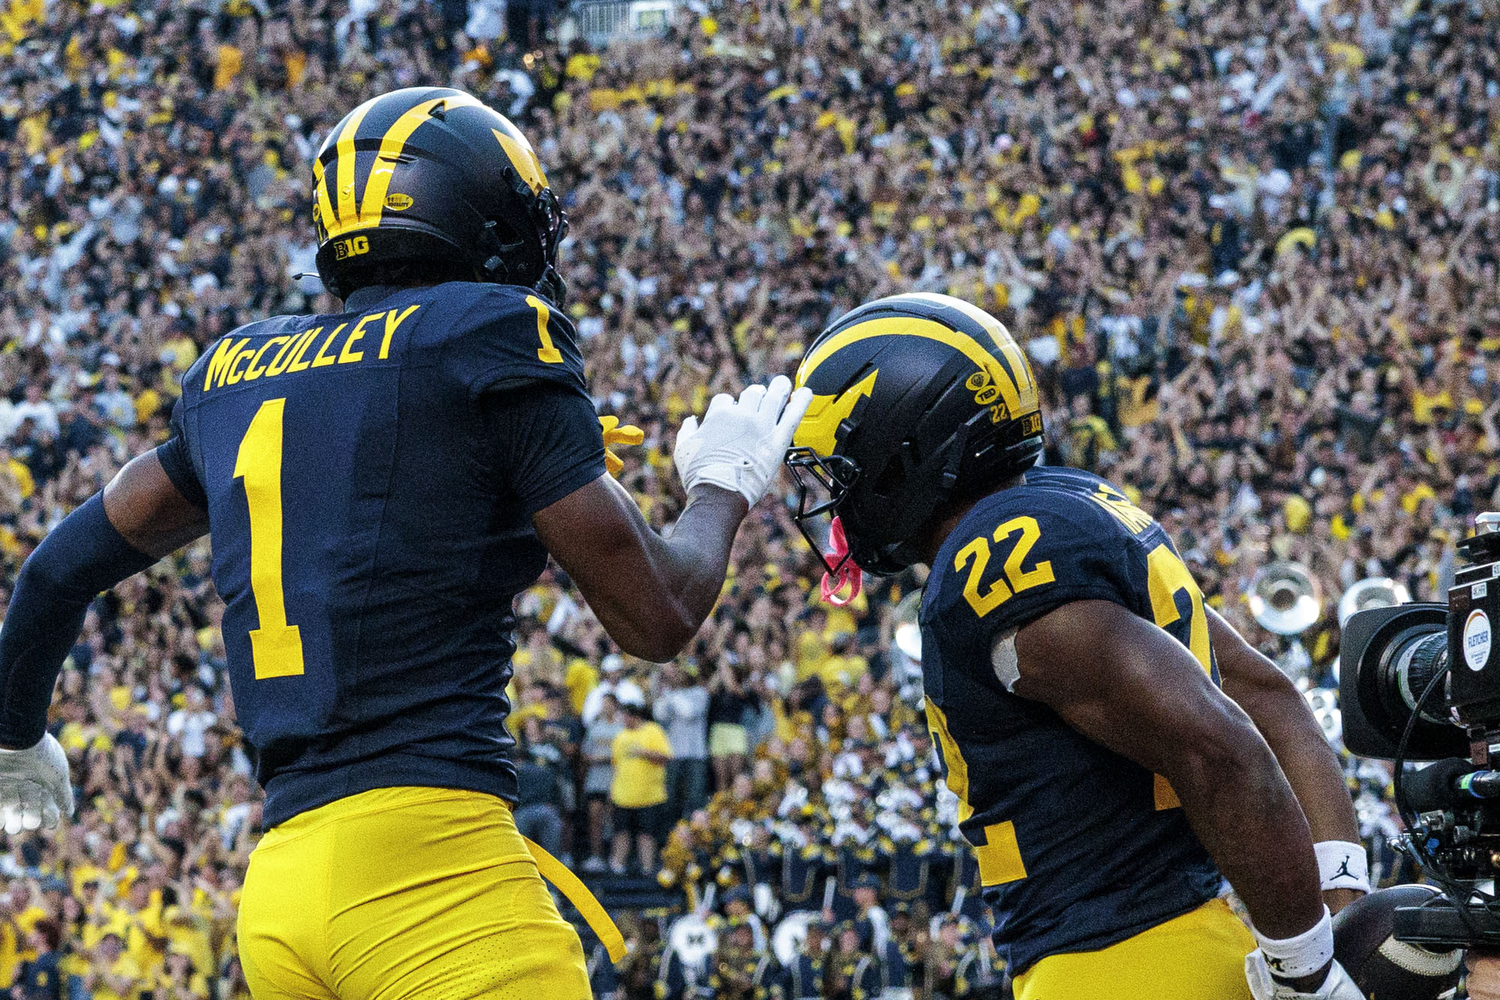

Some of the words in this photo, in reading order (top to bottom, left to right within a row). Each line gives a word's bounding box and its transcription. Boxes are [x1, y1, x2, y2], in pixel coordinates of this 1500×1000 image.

[525, 295, 563, 363] 1
[978, 388, 996, 402] TED
[990, 403, 1008, 424] 22
[233, 397, 304, 679] 1
[954, 516, 1056, 618] 22
[1468, 631, 1488, 648] FLETCHER
